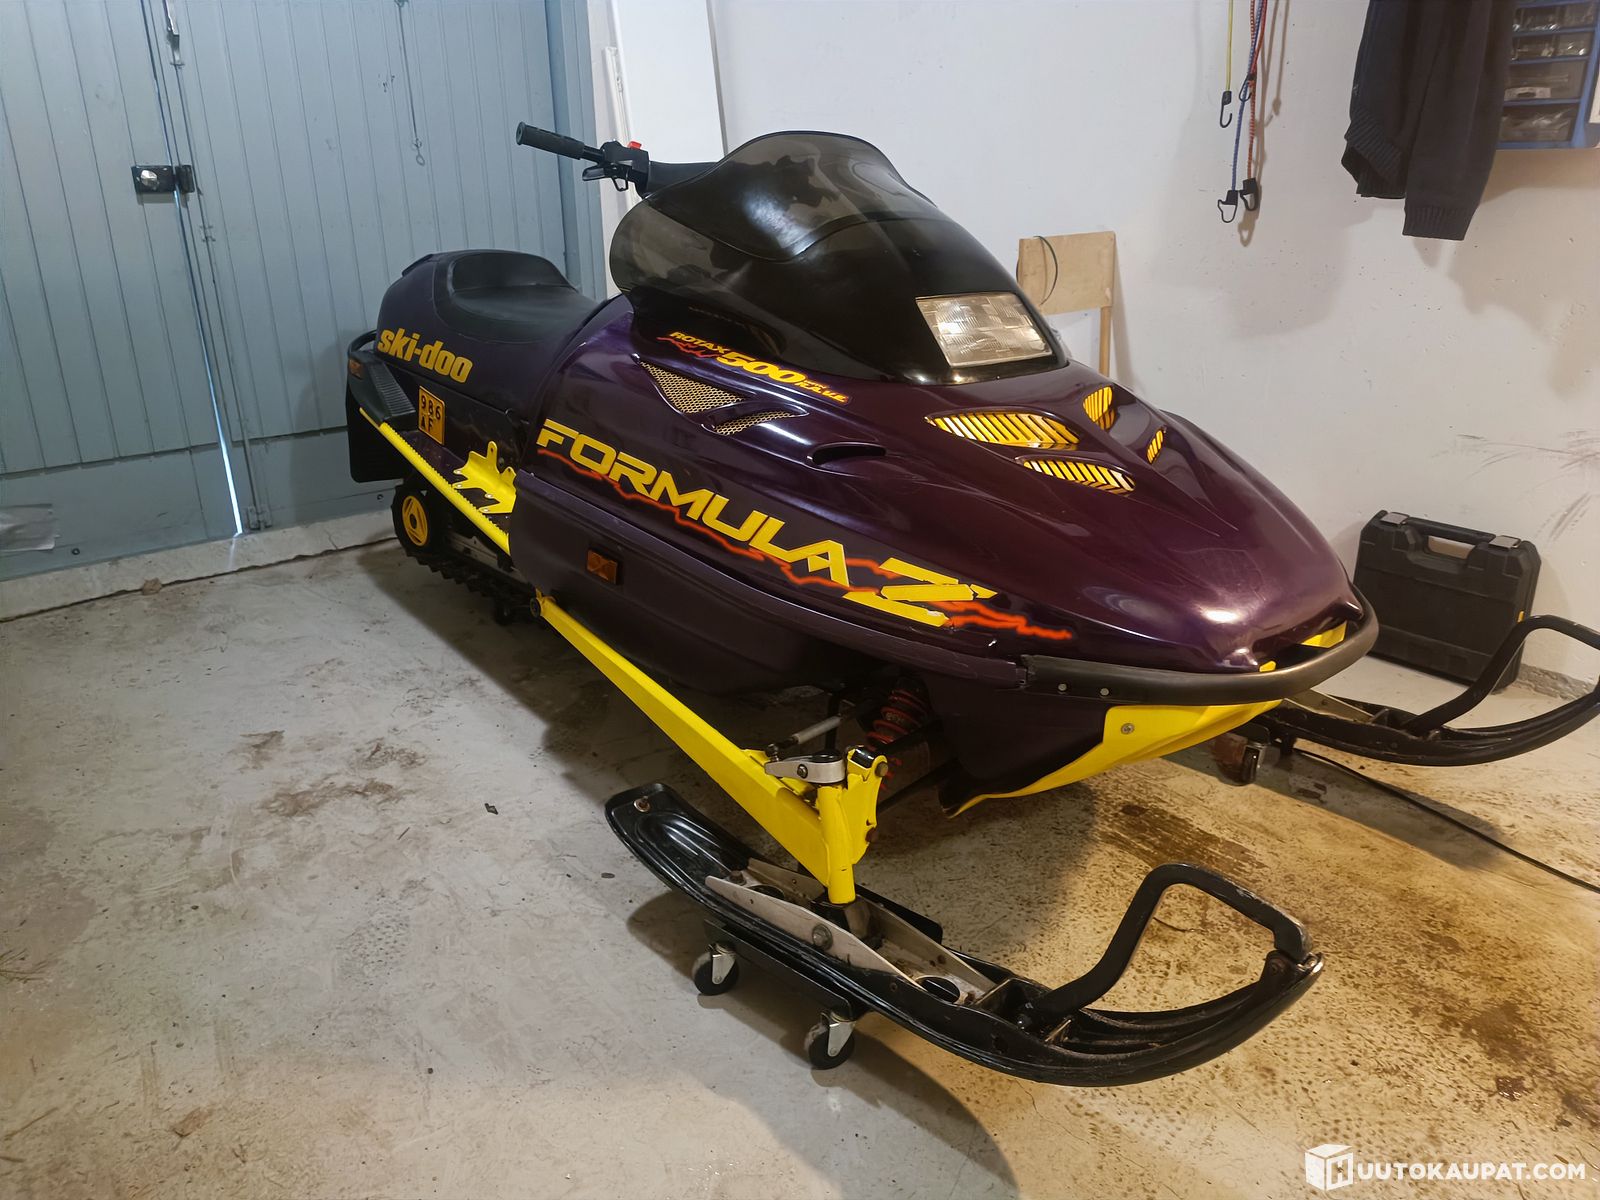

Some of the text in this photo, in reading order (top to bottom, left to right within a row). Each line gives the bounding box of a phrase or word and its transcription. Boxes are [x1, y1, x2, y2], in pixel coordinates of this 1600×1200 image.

[377, 328, 473, 383] ski-doo
[669, 332, 730, 354] ROTAX
[716, 351, 806, 384] 500
[536, 418, 998, 628] FORMULA Z
